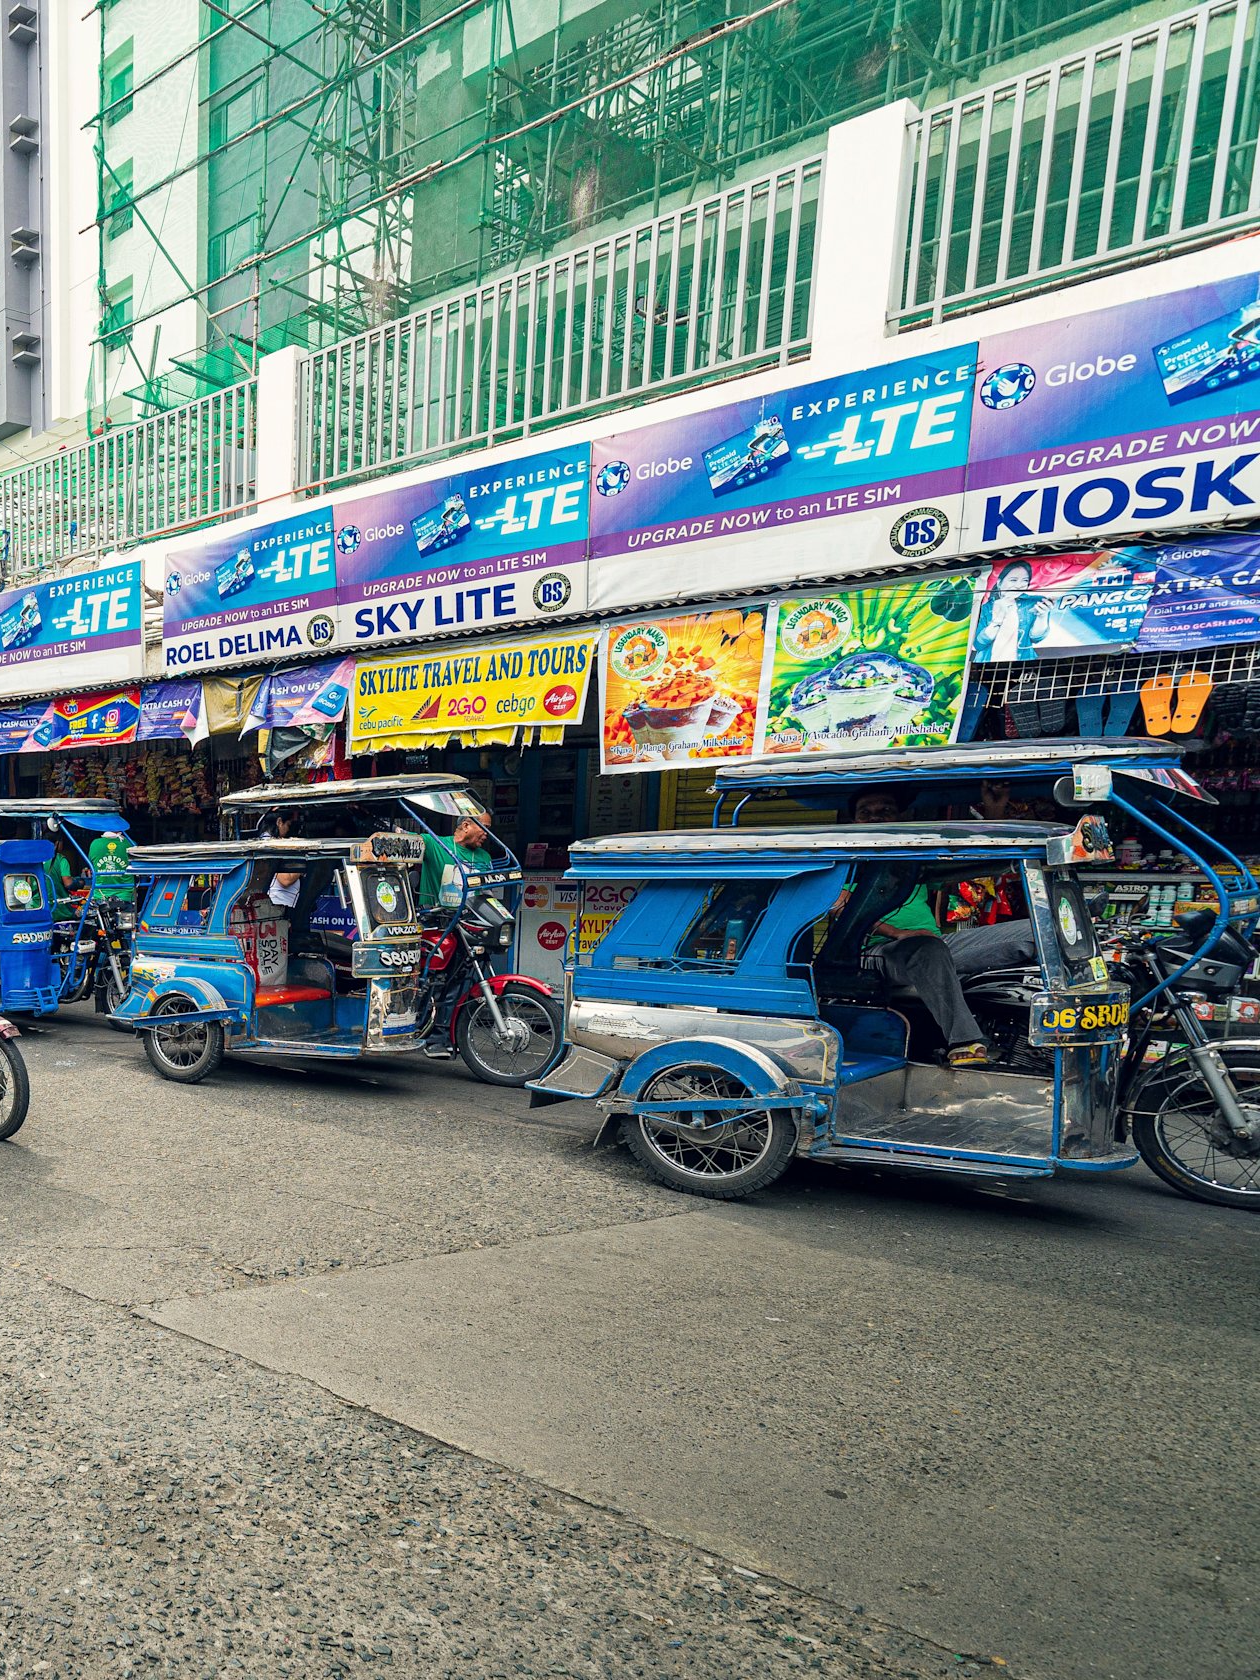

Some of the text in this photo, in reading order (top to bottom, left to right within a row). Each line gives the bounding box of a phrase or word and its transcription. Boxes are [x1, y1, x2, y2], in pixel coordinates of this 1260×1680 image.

[1163, 341, 1209, 366] Prepaid
[1044, 353, 1137, 387] Globe
[791, 364, 970, 421] EXPERIENCE
[815, 390, 965, 466] LTE
[1027, 417, 1260, 474] UPGRADE NOW
[636, 456, 693, 481] Globe
[708, 449, 737, 467] Prepaid
[469, 460, 587, 498] EXPERIENCE
[488, 480, 584, 536] LTE
[982, 452, 1260, 543] KIOSK
[627, 484, 901, 548] UPGRADE NOW to an LTE SIM
[253, 522, 332, 552] EXPERIENCE
[364, 523, 405, 542] Globe
[904, 518, 936, 547] BS
[266, 538, 331, 583] LTE
[901, 544, 937, 557] BICUTAN
[1171, 549, 1211, 560] Globe
[49, 569, 134, 598] EXPERIENCE
[184, 571, 211, 586] Globe
[362, 552, 547, 597] UPGRADE NOW to an LTE SIM
[1096, 574, 1123, 585] TM
[1154, 575, 1224, 595] XTRA
[542, 581, 563, 603] BS
[62, 587, 131, 636] LTE
[181, 597, 309, 632] UPGRADE NOW to an LTE SIM
[354, 582, 516, 639] SKY LITE
[785, 601, 848, 630] LEGENDARY MANGO
[1154, 607, 1173, 615] Dial
[1208, 599, 1228, 609] and
[313, 621, 329, 640] BS
[1140, 617, 1254, 633] OWNLOAD GCASH NOW
[9, 649, 31, 662] NOW
[32, 648, 42, 659] to
[42, 647, 53, 656] an
[54, 643, 70, 655] LTE
[70, 640, 86, 652] SIM
[166, 625, 303, 666] ROEL DELIMA
[614, 627, 665, 653] LEGENDARY MANGO
[359, 664, 420, 697] SKYLITE
[422, 655, 482, 689] TRAVEL
[485, 651, 523, 682] AND
[527, 643, 587, 677] TOURS
[269, 682, 321, 696] ASH ON US
[141, 699, 183, 711] EXTRA CASH
[447, 695, 487, 717] 2GO
[496, 693, 536, 717] cebgo
[552, 703, 569, 711] ZEST
[2, 719, 19, 729] CASH
[69, 717, 88, 730] FREE
[359, 716, 403, 732] cebu pacific
[463, 714, 485, 723] TRAVEL
[668, 741, 699, 753] Graham
[807, 730, 848, 741] Avocado
[851, 729, 890, 742] Graham
[586, 885, 638, 904] 2GO
[1114, 884, 1149, 893] ASTRO
[309, 916, 329, 925] ASH
[331, 917, 344, 925] ON
[260, 939, 273, 975] SALE
[269, 939, 279, 966] DAY
